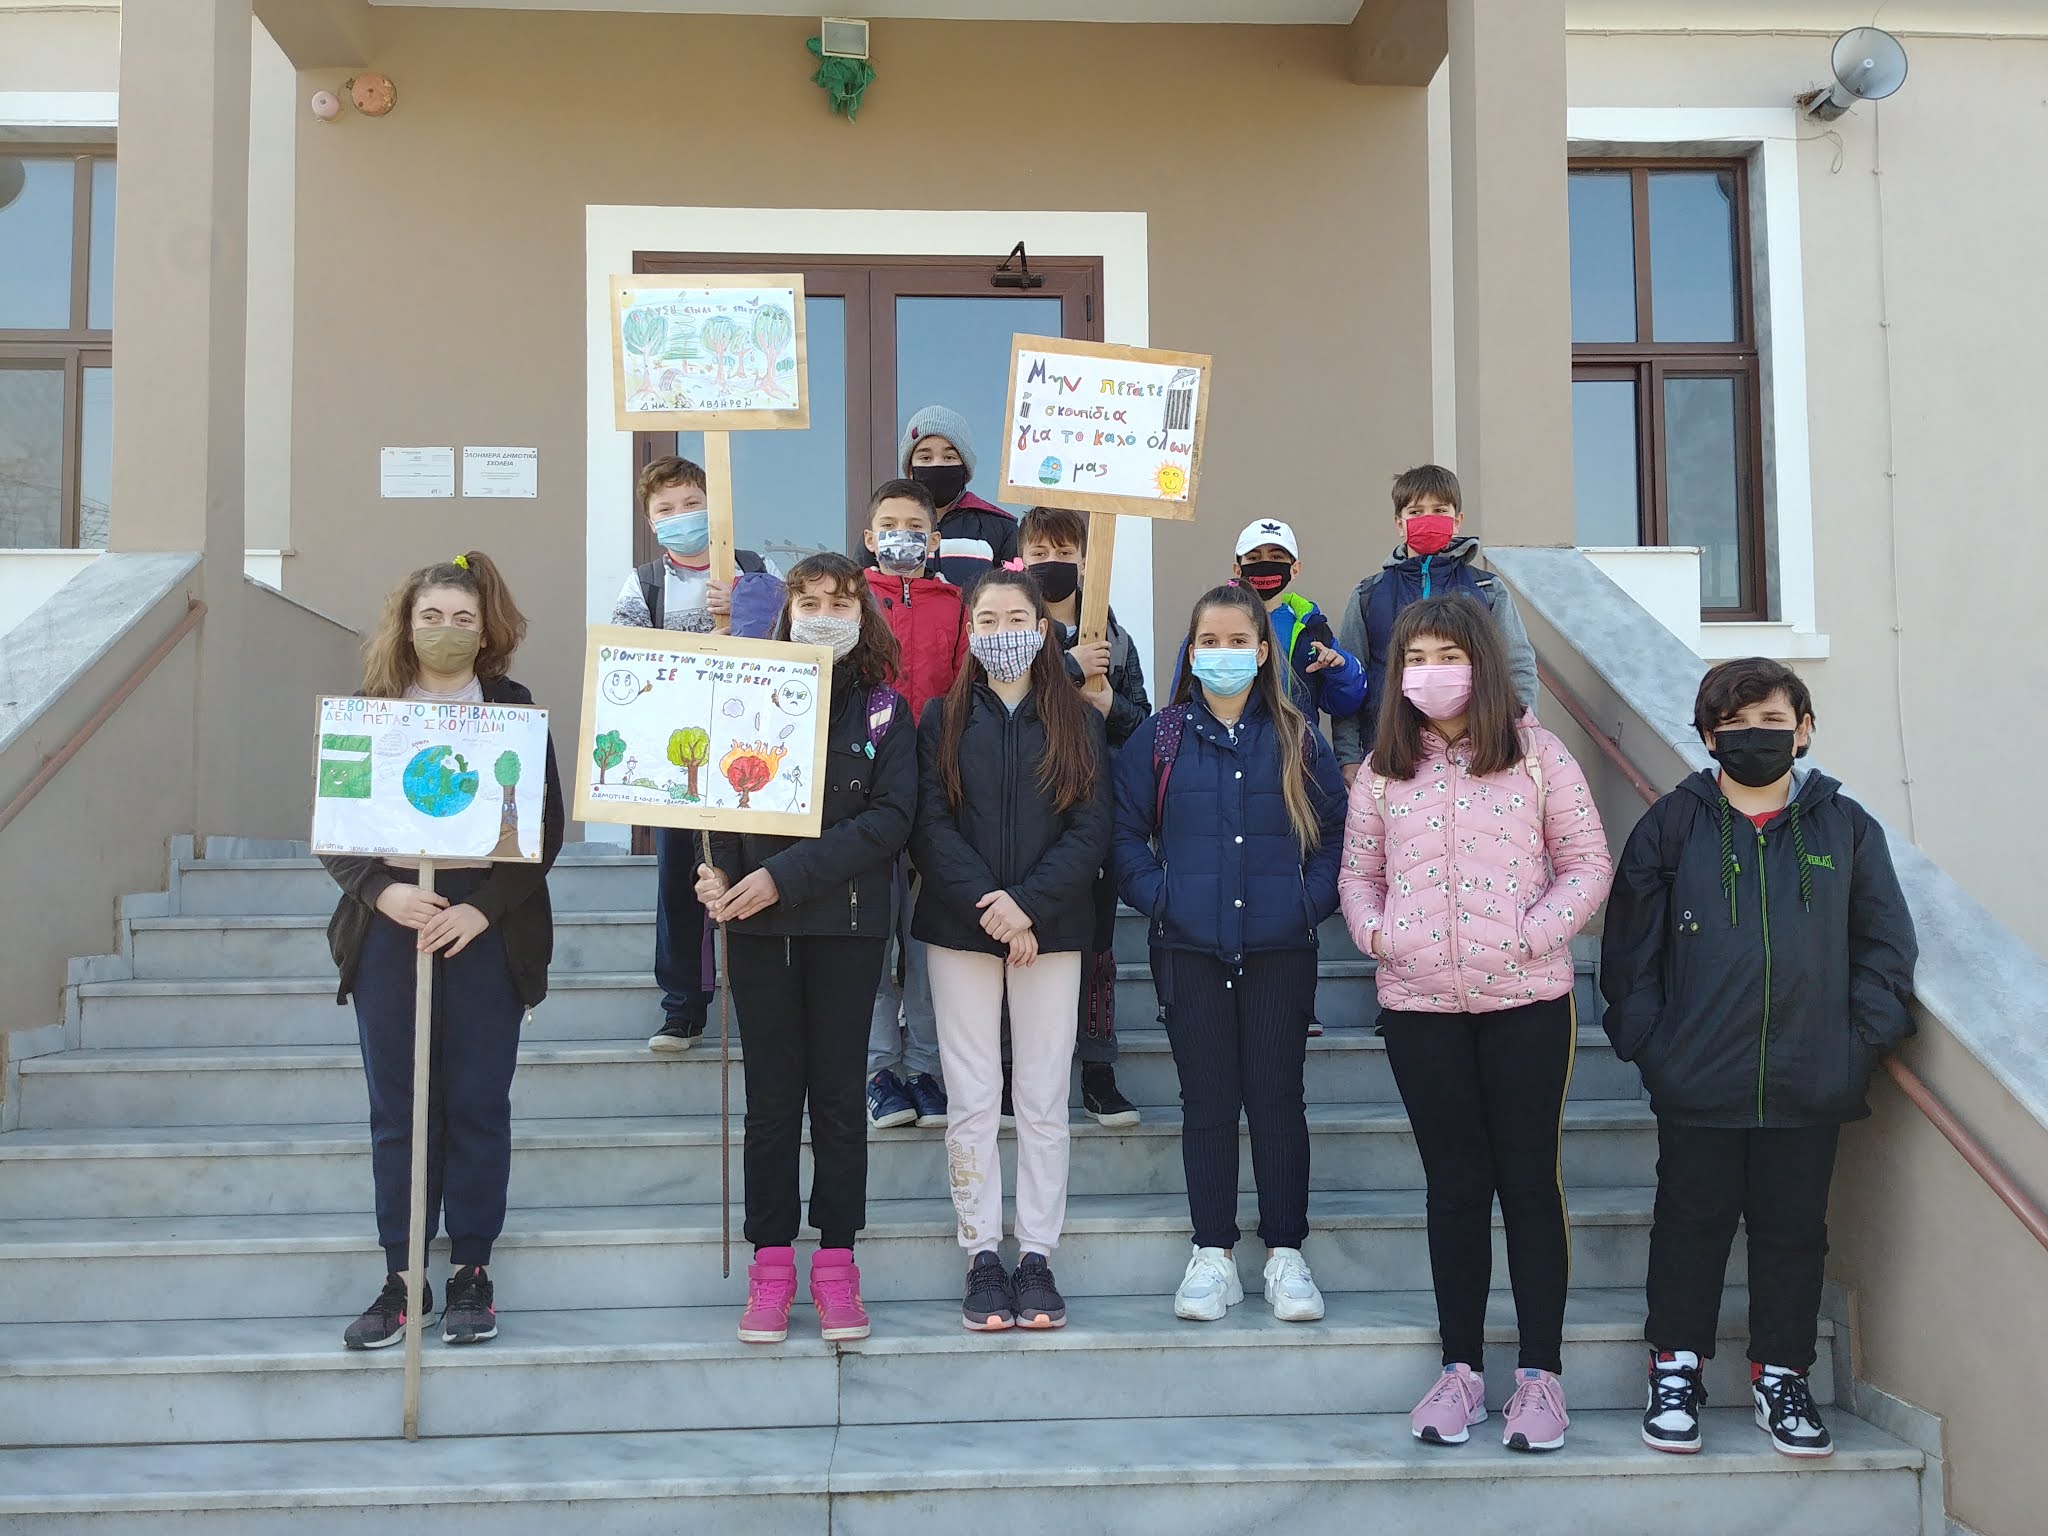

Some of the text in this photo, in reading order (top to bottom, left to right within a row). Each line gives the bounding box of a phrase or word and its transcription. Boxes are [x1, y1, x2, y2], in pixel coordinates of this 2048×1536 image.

[1027, 358, 1163, 397] Μην πετάτε
[1045, 405, 1127, 424] σκουπίδια
[1017, 424, 1192, 456] για το καλό όλων
[1073, 462, 1109, 483] μας
[600, 647, 665, 663] ΦΡΟΝΤΙΣΕ
[670, 654, 696, 664] ΤΗΝ
[704, 657, 735, 671] ΦΥΣΗ
[740, 662, 761, 672] ΓΙΑ
[655, 668, 772, 687] ΣΕ ΤΙΜΩΡΗΣΕΙ
[325, 711, 353, 722] ΔΕΝ
[328, 699, 392, 713] ΣΕΒΟΜΑΙ
[405, 704, 426, 717] ΤΟ
